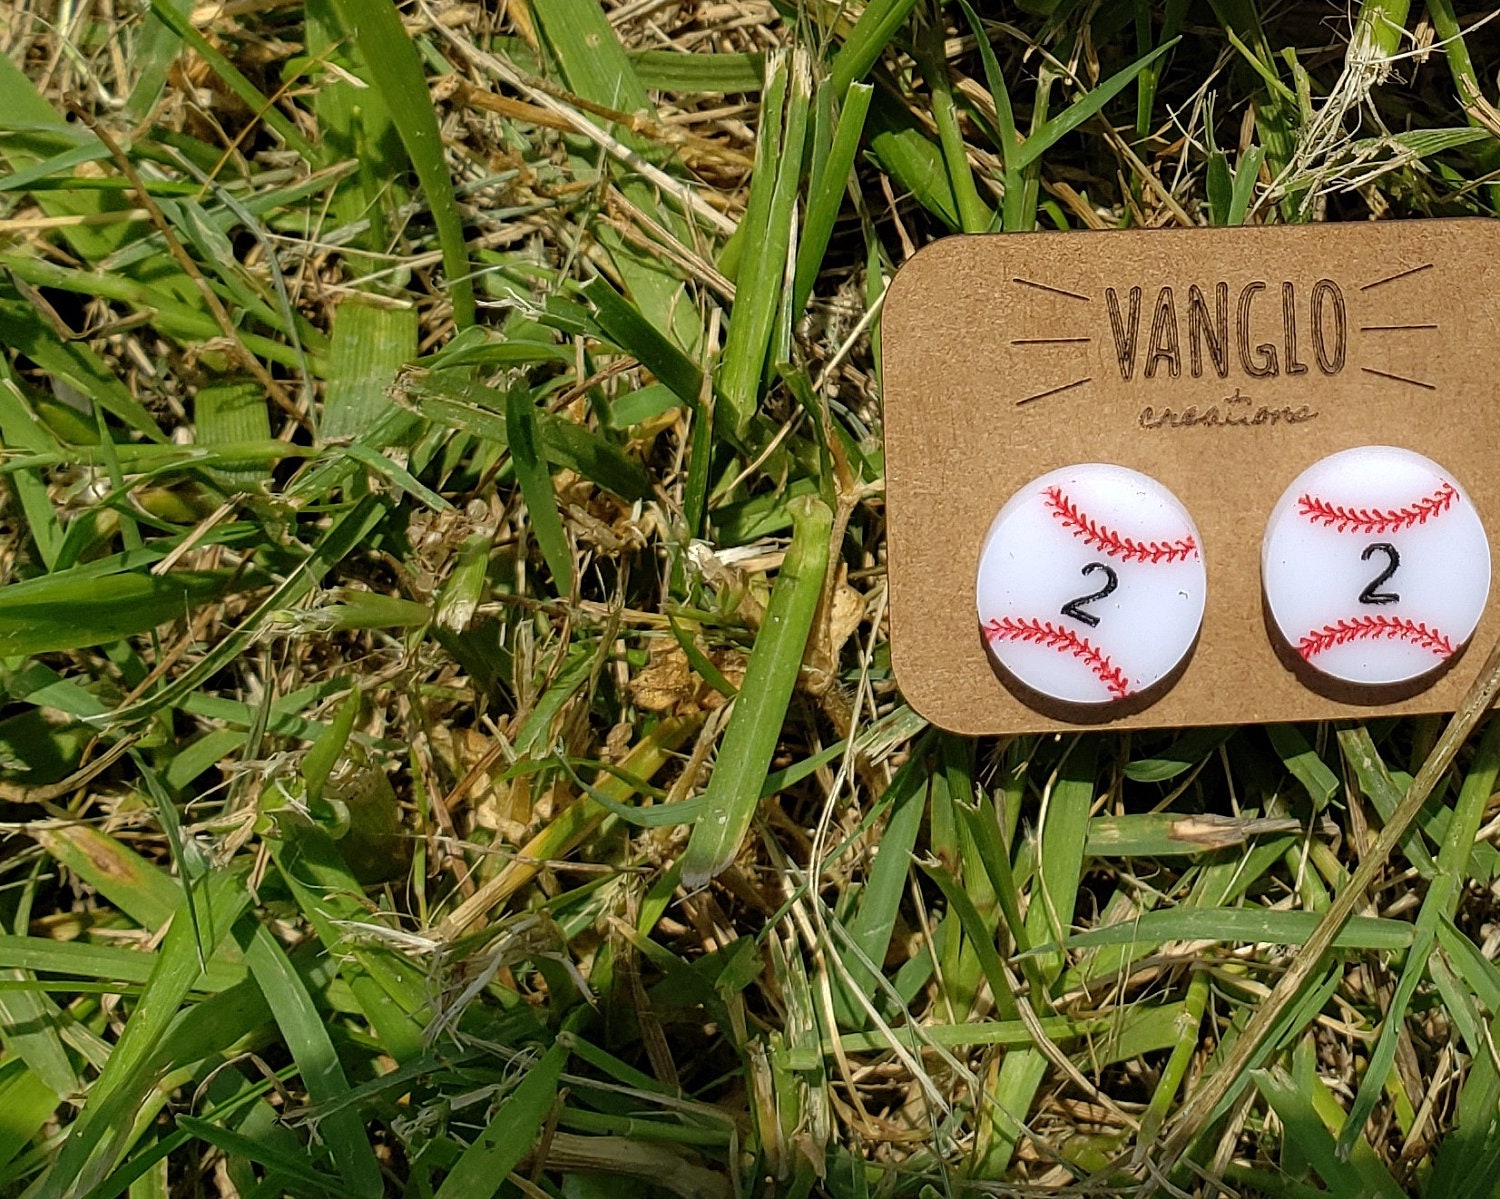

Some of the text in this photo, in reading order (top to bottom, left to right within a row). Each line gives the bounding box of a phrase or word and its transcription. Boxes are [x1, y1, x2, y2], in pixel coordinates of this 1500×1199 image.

[1104, 278, 1348, 382] VANGLO
[1138, 388, 1320, 430] creations
[1060, 561, 1119, 630] 2
[1359, 541, 1402, 606] 2
